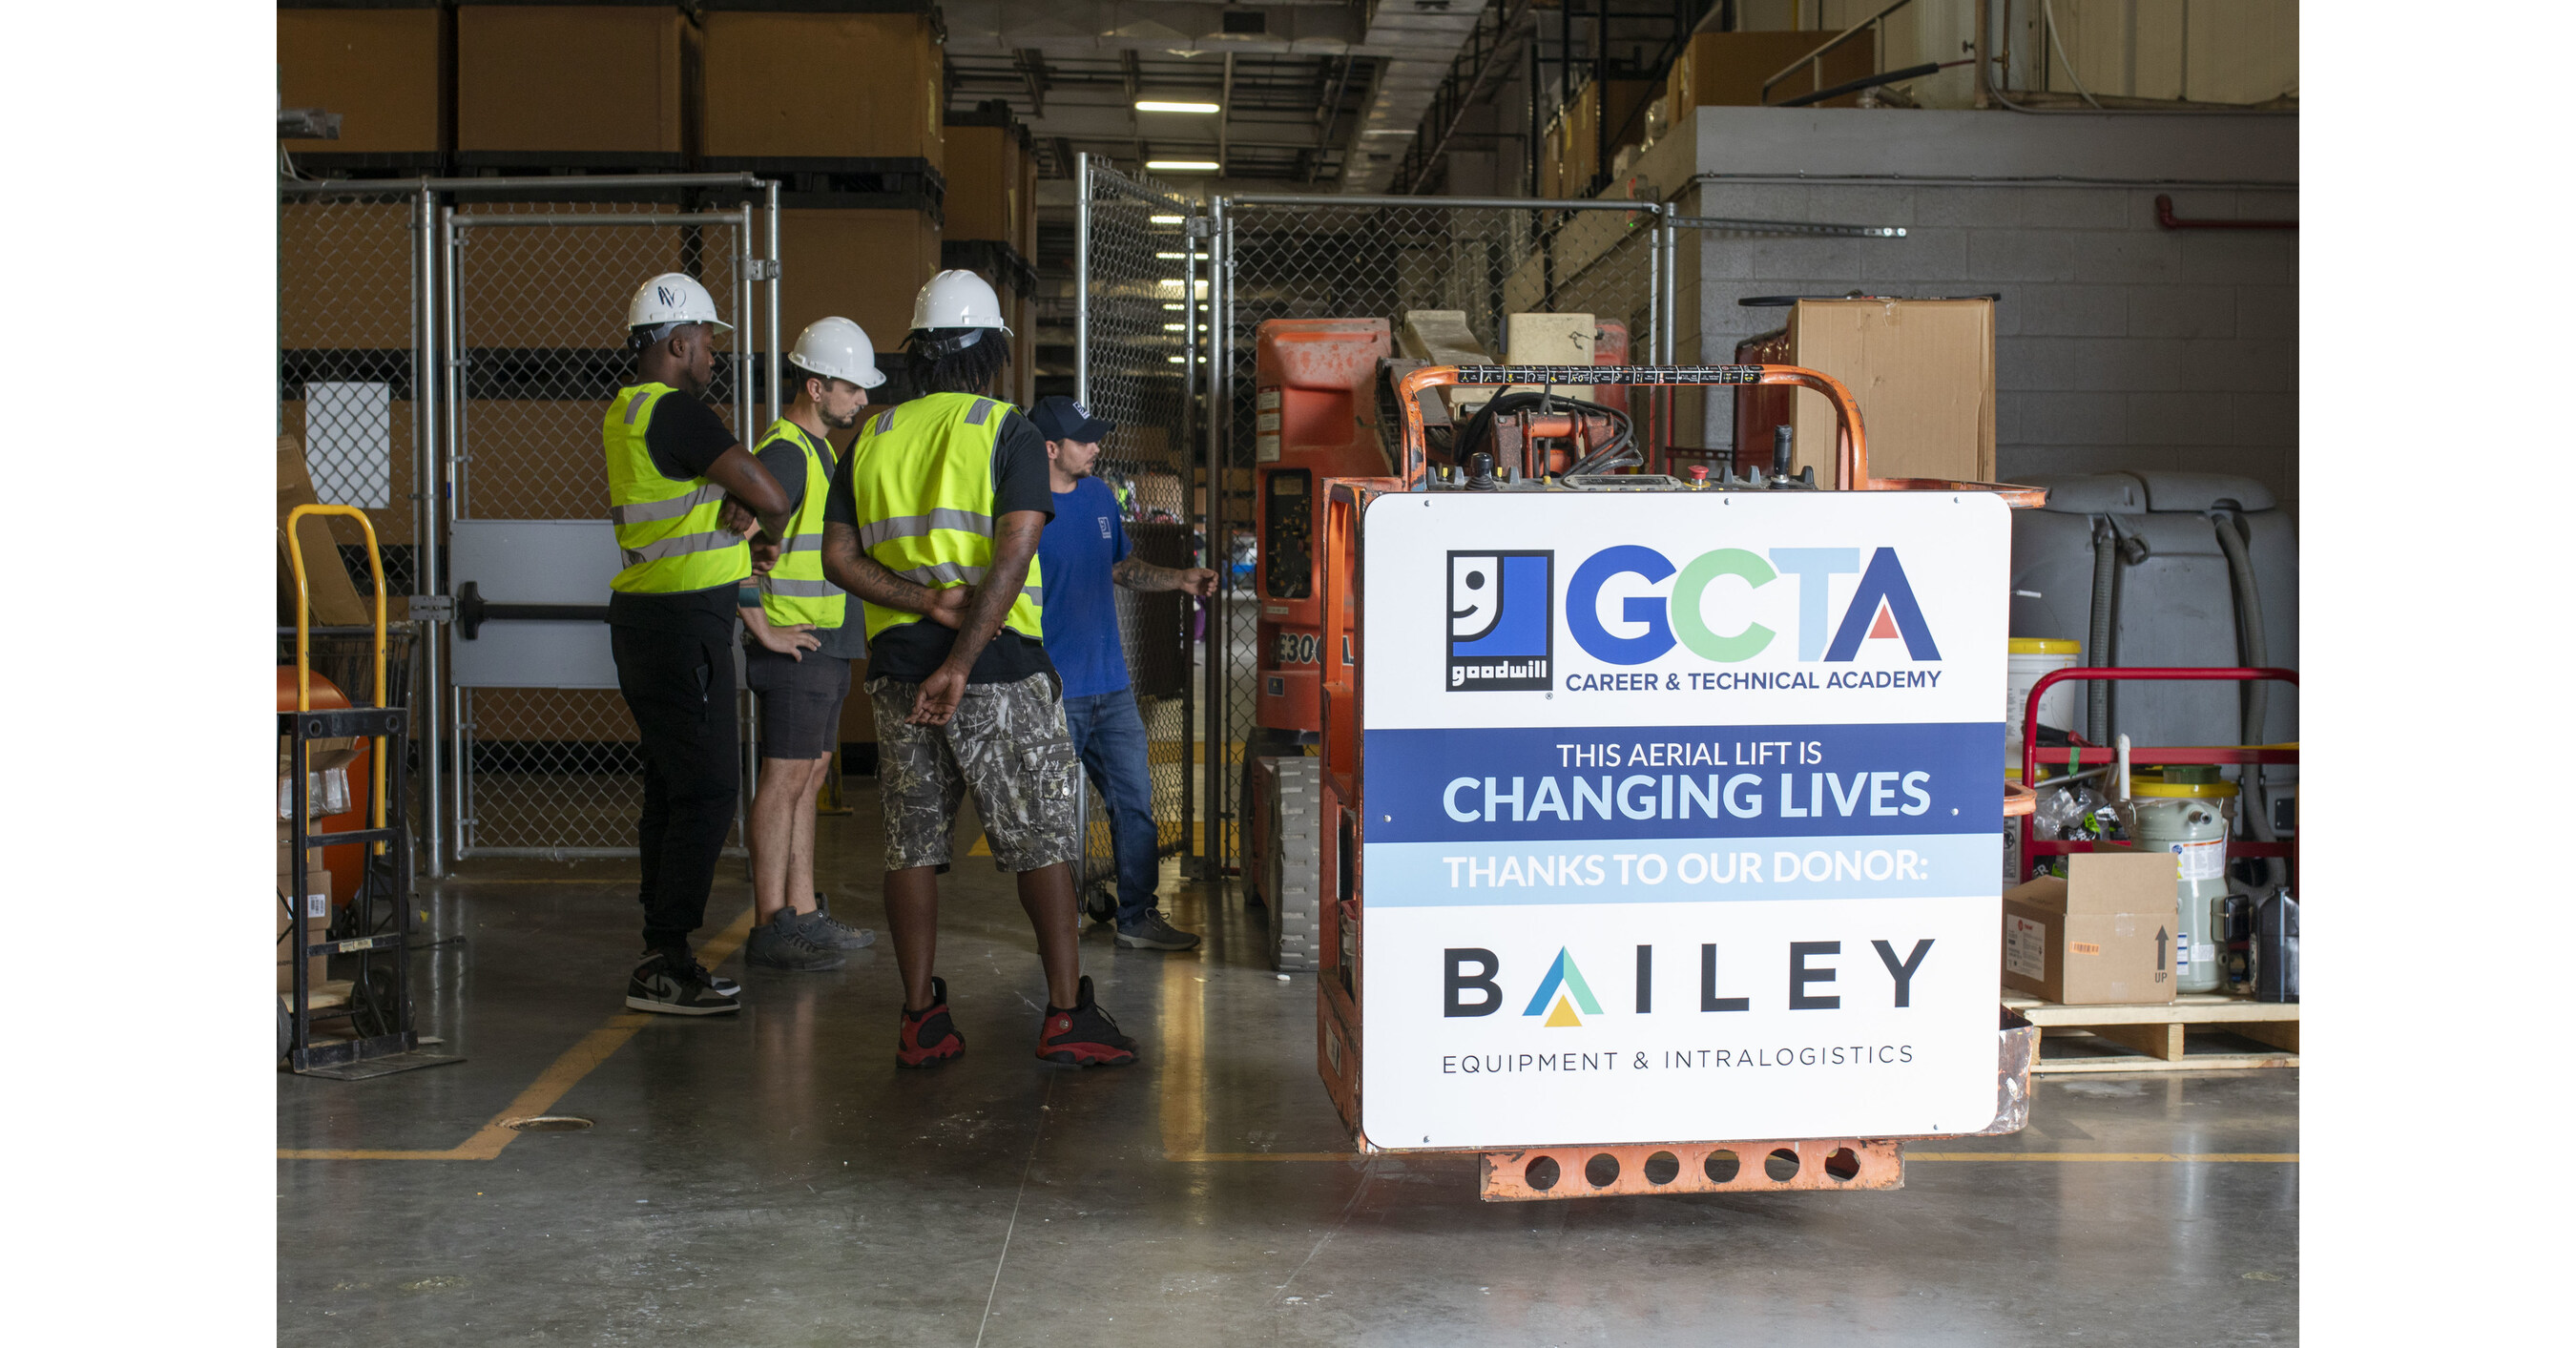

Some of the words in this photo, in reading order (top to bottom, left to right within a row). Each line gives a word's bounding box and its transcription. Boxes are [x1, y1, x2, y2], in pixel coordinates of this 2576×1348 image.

[1566, 545, 1942, 665] GCTA
[1452, 660, 1547, 686] goodwill
[1566, 673, 1659, 692] CAREER
[1666, 673, 1681, 691] &
[1688, 671, 1819, 691] TECHNICAL
[1826, 671, 1942, 689] ACADEMY
[1556, 744, 1621, 767] THIS
[1628, 742, 1728, 766] AERIAL
[1735, 741, 1792, 765] LIFT
[1800, 741, 1822, 765] IS
[1443, 774, 1762, 822] CHANGING
[1781, 771, 1930, 818] LIVES
[1443, 855, 1605, 888] THANKS
[1613, 853, 1668, 885] TO
[1677, 852, 1763, 884] OUR
[1774, 849, 1928, 882] DONOR:
[1444, 939, 1935, 1027] BAILEY
[2154, 972, 2168, 984] UP
[1443, 1052, 1617, 1074] EQUIPMENT
[1633, 1051, 1649, 1069] &
[1665, 1045, 1913, 1068] INTRALOGISTICS
